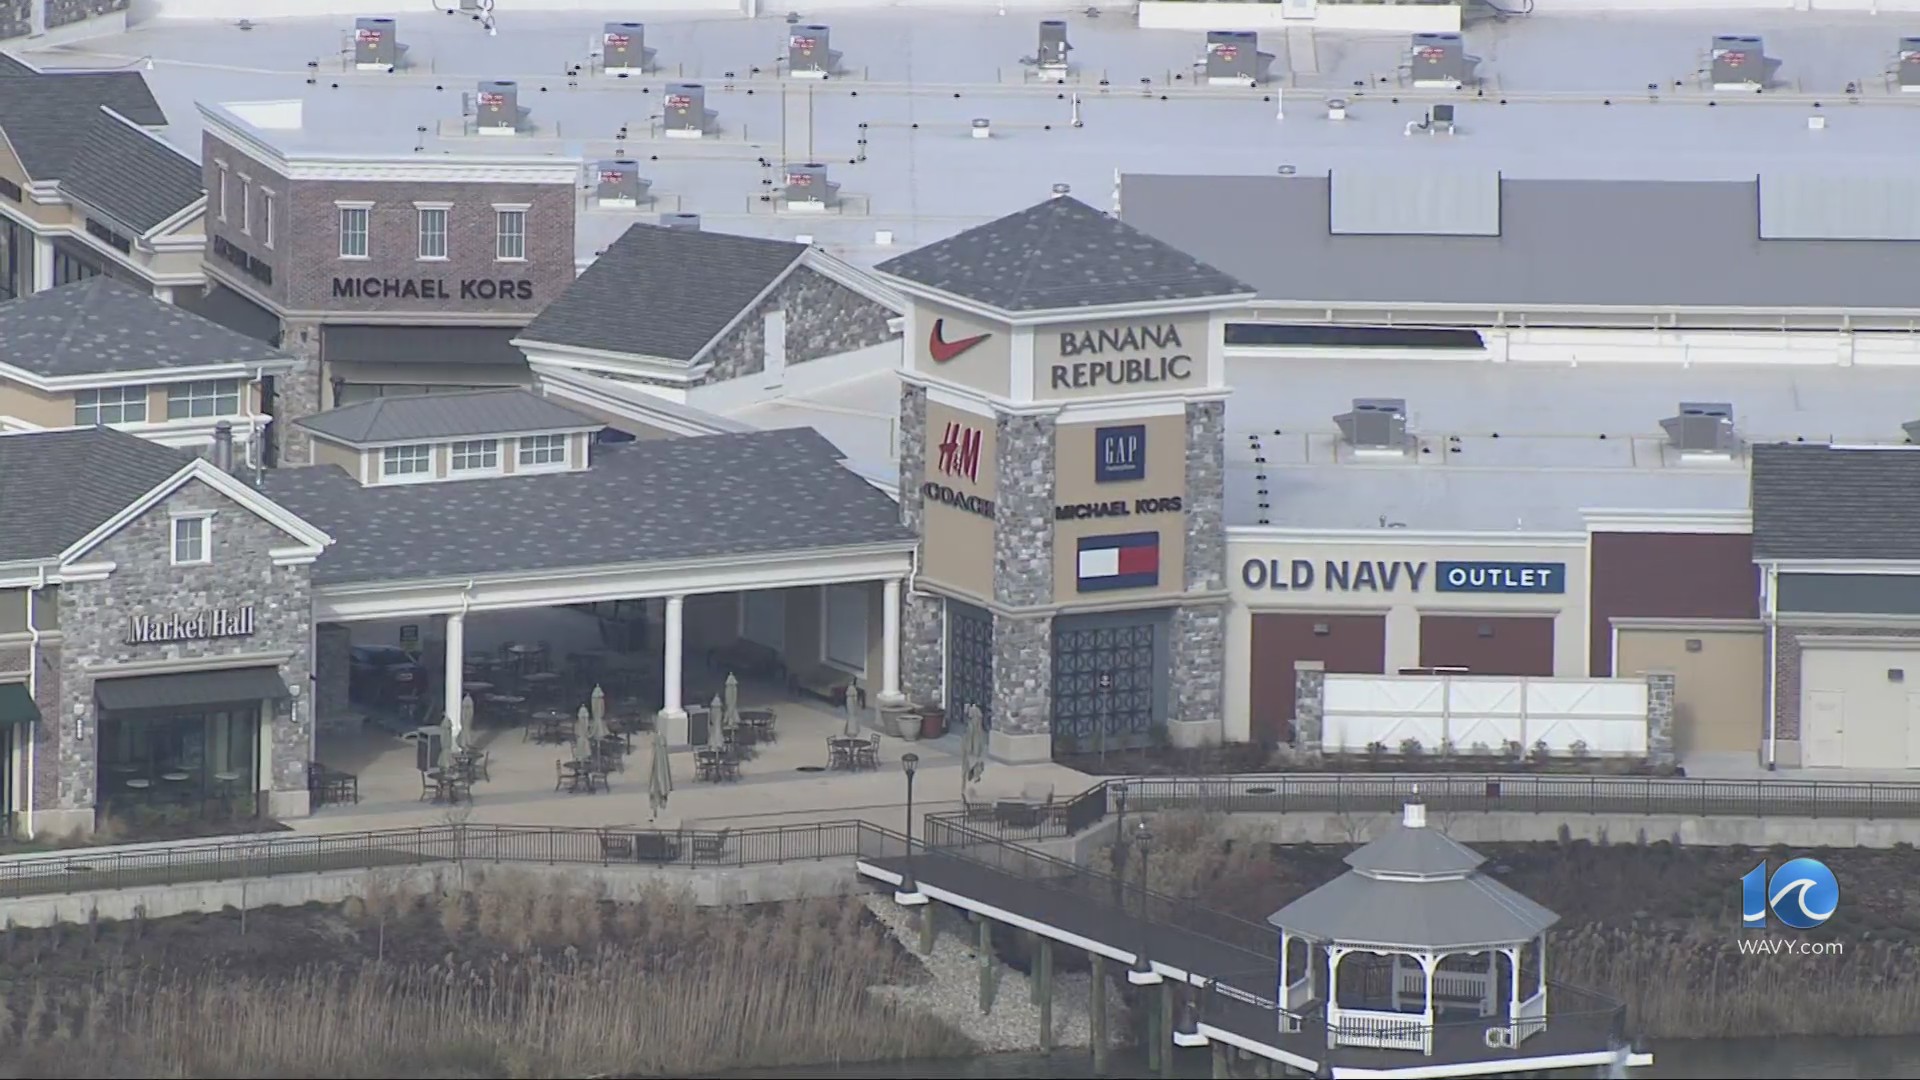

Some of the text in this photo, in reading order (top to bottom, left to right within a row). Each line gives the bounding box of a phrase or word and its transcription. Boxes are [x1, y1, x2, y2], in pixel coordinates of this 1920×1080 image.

[333, 277, 533, 300] MICHAEL KORS
[1060, 323, 1182, 357] BANANA
[1051, 354, 1192, 389] REPUBLIC
[938, 421, 983, 485] H&M
[1105, 435, 1137, 464] GAP
[923, 482, 996, 519] COACH
[1055, 496, 1182, 521] MICHAEL KORS
[1242, 558, 1427, 592] OLD NAVY
[1448, 568, 1552, 587] OUTLET
[126, 606, 254, 643] Market Hall
